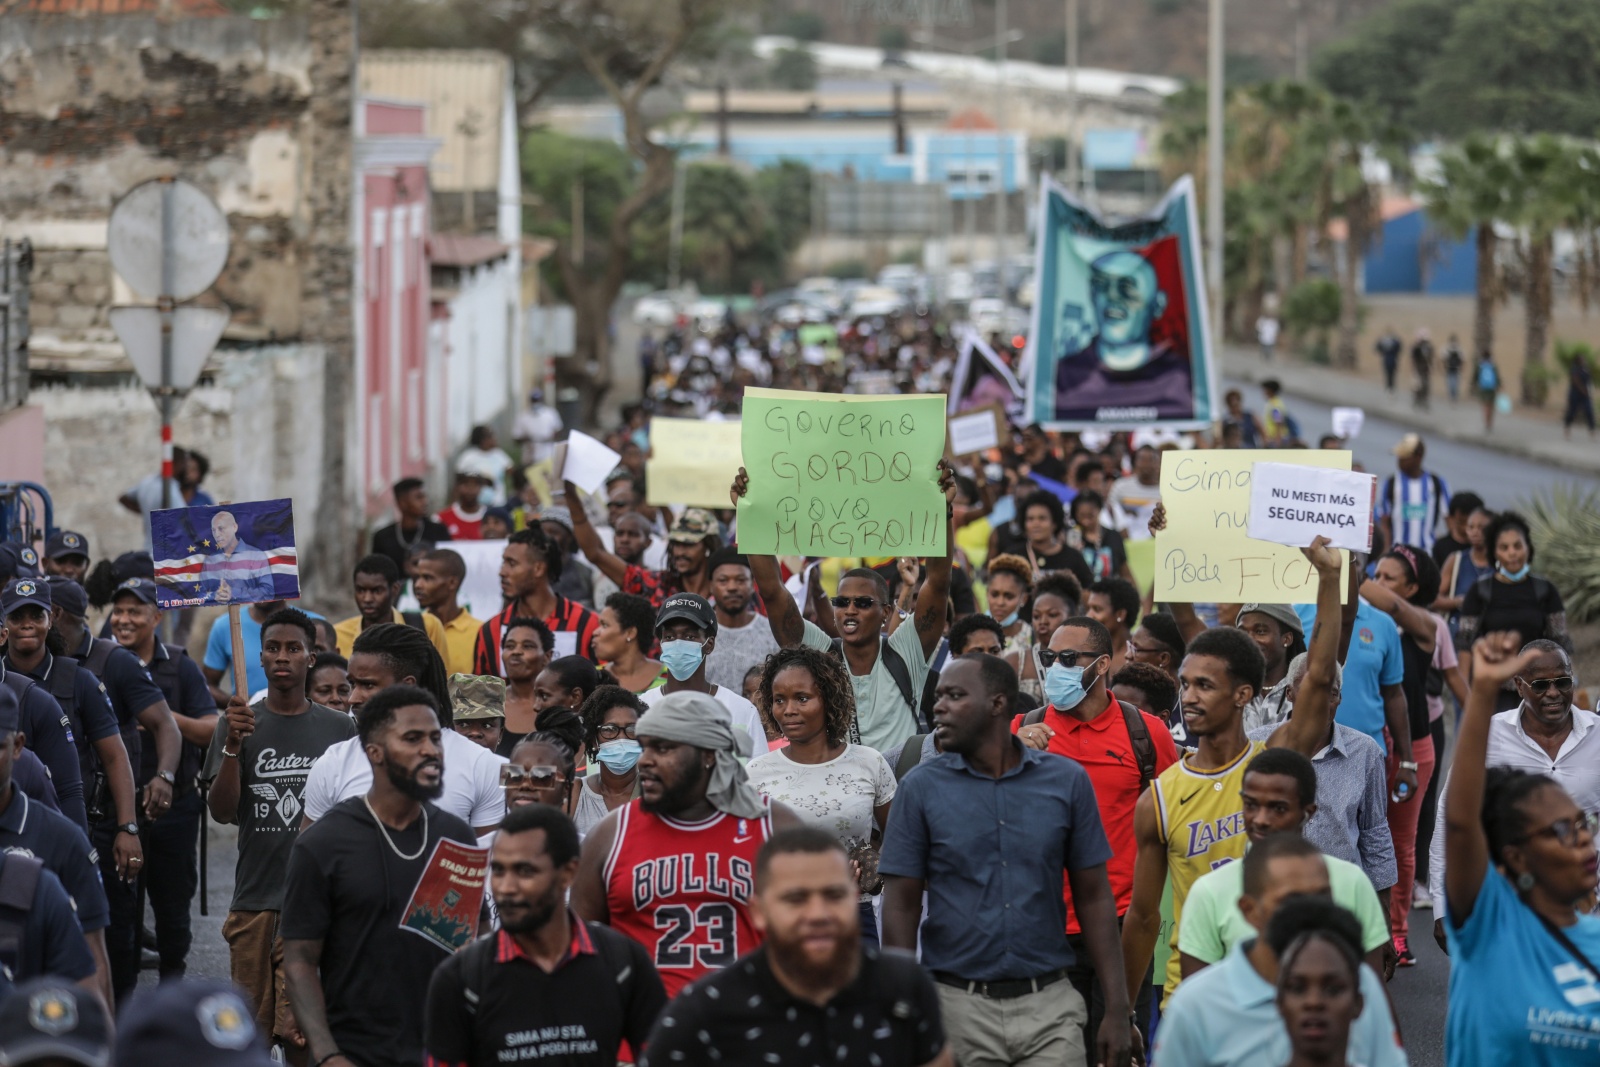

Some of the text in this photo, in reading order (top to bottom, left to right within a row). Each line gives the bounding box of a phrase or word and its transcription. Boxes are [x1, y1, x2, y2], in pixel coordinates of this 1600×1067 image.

[772, 451, 912, 494] GORDO
[777, 496, 869, 522] POVO
[1272, 488, 1355, 506] NU MESTI MÁS
[1268, 506, 1355, 528] SEGURANÇA
[775, 511, 938, 555] MAGRO!!!
[666, 598, 702, 610] BOSTON
[254, 803, 269, 818] 19
[1186, 811, 1247, 858] LAKE
[633, 853, 754, 911] BULLS
[653, 902, 738, 968] 23
[504, 1024, 586, 1047] SIMA NU STA
[497, 1048, 519, 1062] NU
[520, 1045, 539, 1060] KA
[569, 1040, 598, 1054] FIKA
